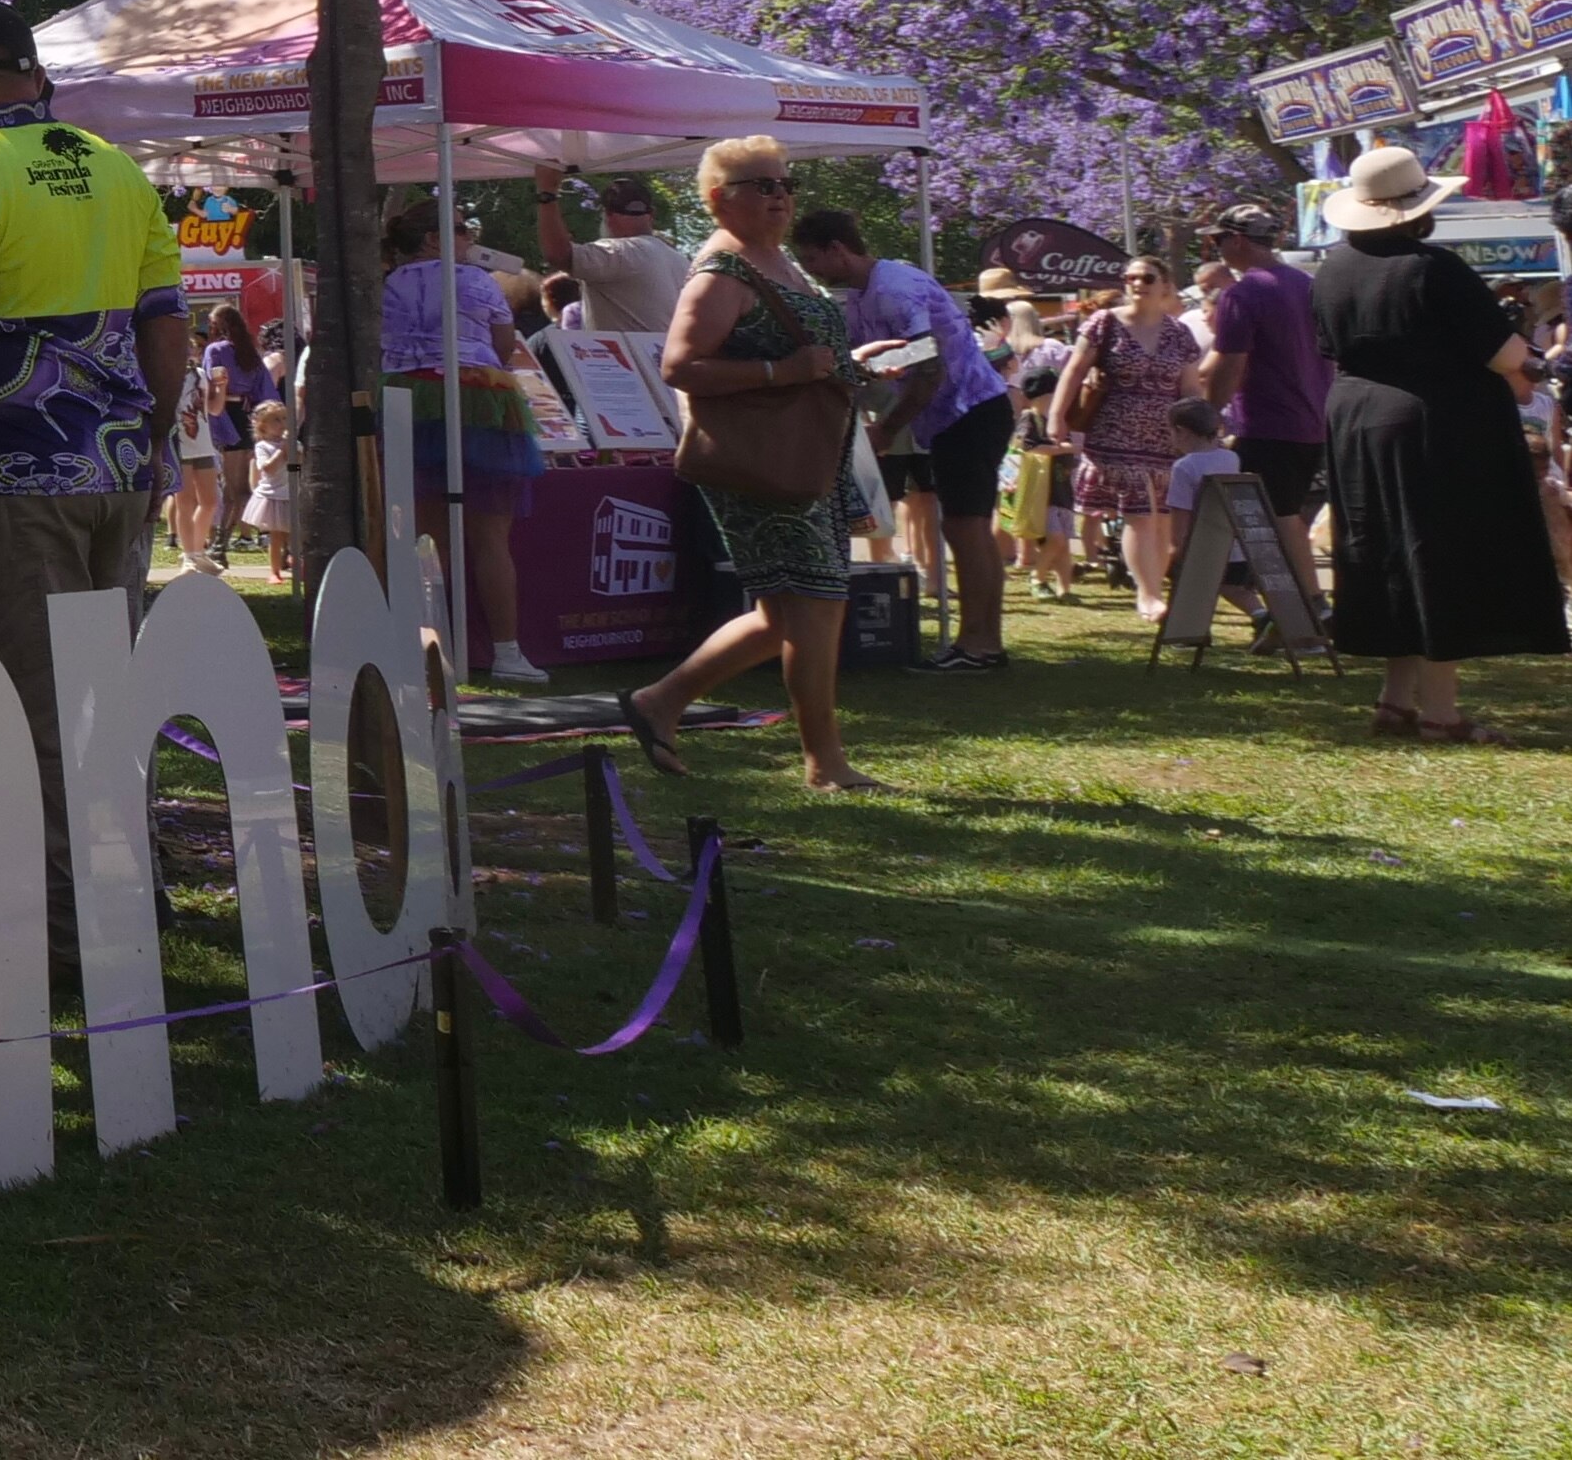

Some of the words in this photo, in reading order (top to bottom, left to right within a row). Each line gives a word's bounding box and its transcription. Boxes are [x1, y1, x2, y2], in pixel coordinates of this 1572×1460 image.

[195, 76, 225, 92] THE
[229, 72, 266, 90] NEW
[271, 68, 310, 86] SCH
[386, 57, 424, 77] RTS
[201, 92, 313, 114] NEIGHBOURHO
[386, 83, 418, 101] INC.
[180, 211, 251, 253] Guy!
[1041, 252, 1121, 276] Coffee
